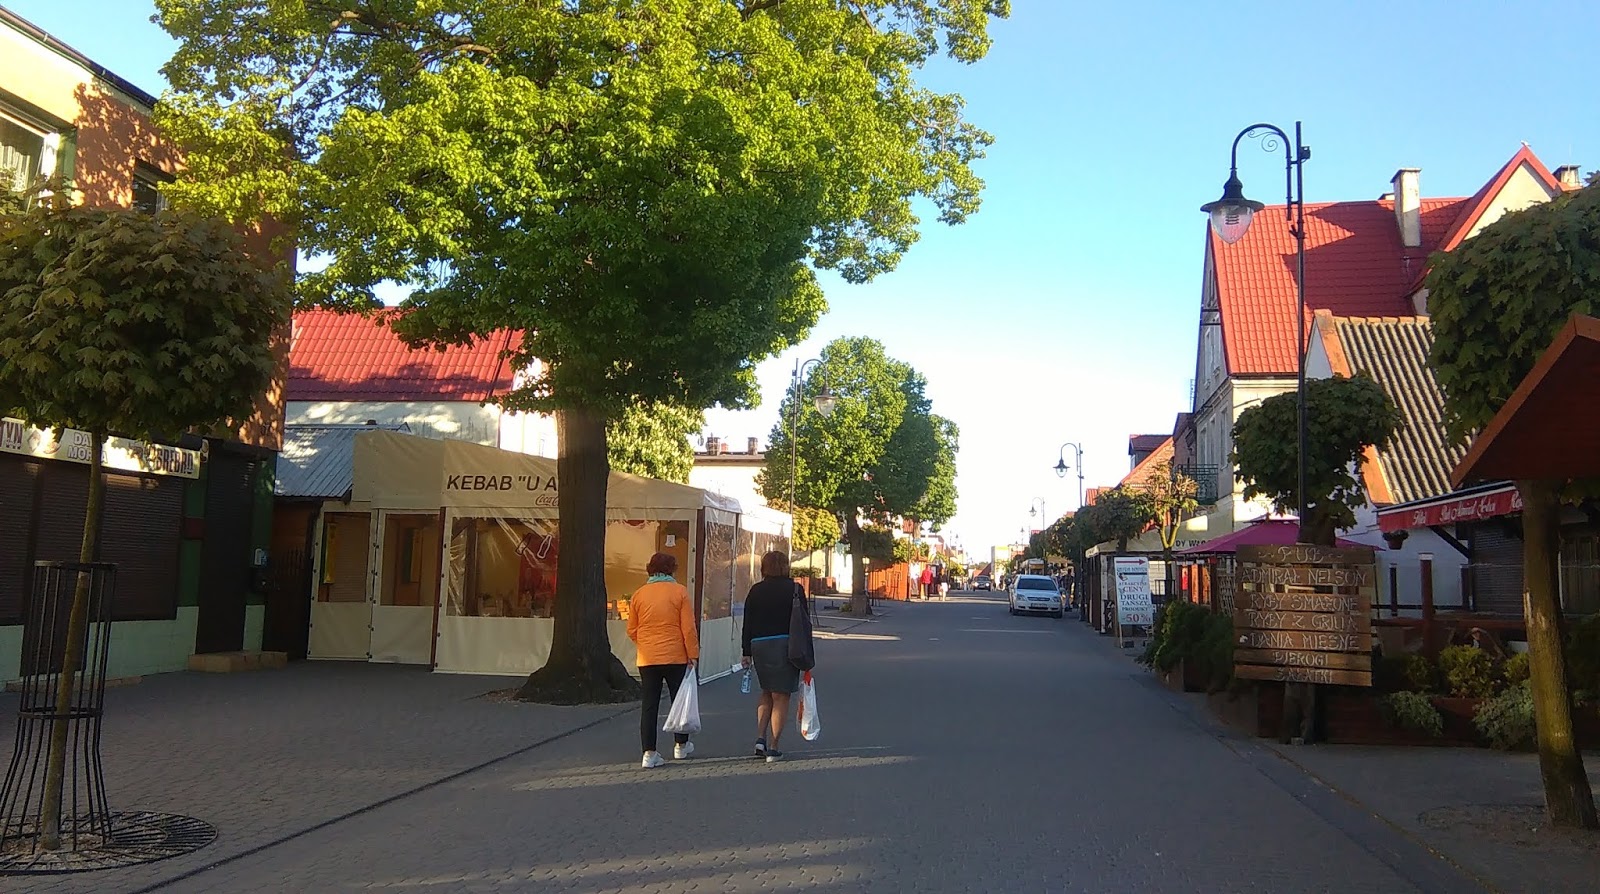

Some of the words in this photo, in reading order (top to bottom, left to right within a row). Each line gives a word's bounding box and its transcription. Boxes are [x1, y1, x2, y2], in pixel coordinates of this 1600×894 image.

[74, 432, 92, 448] DA
[68, 445, 108, 464] MORA
[447, 475, 512, 490] KEBAB
[1308, 569, 1367, 586] NELSON
